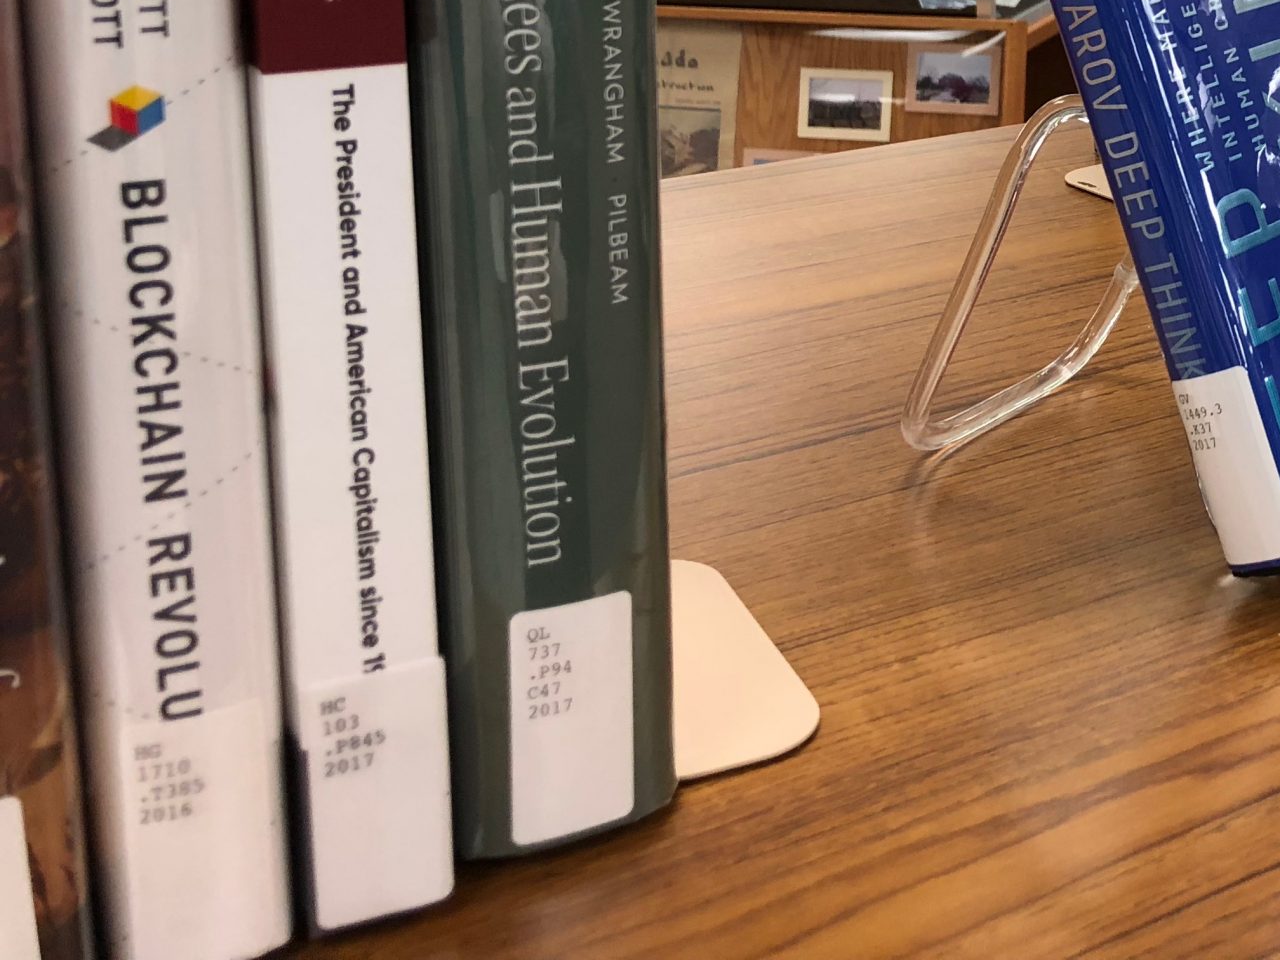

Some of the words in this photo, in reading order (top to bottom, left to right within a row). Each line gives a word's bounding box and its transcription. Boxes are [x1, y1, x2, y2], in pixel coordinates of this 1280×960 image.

[331, 84, 355, 132] The
[506, 86, 554, 165] and
[601, 0, 625, 163] WRANGHAM
[1170, 66, 1215, 174] WHERE
[1224, 46, 1265, 153] HUMAN
[334, 139, 362, 259] President
[607, 194, 628, 305] PILBEAM
[340, 266, 367, 315] and
[509, 176, 563, 348] Human
[1104, 132, 1165, 239] DEEP
[1145, 252, 1206, 379] THINK
[120, 179, 188, 503] BLOCKCHAIN
[345, 323, 372, 442] American
[349, 445, 380, 580] Capitalism
[517, 355, 576, 568] Evolution
[147, 532, 205, 722] REVOLU
[360, 584, 383, 648] since
[527, 627, 550, 643] QL
[528, 643, 560, 660] 737
[530, 660, 571, 679] .P94
[527, 681, 560, 700] C47
[528, 698, 572, 719] 2017
